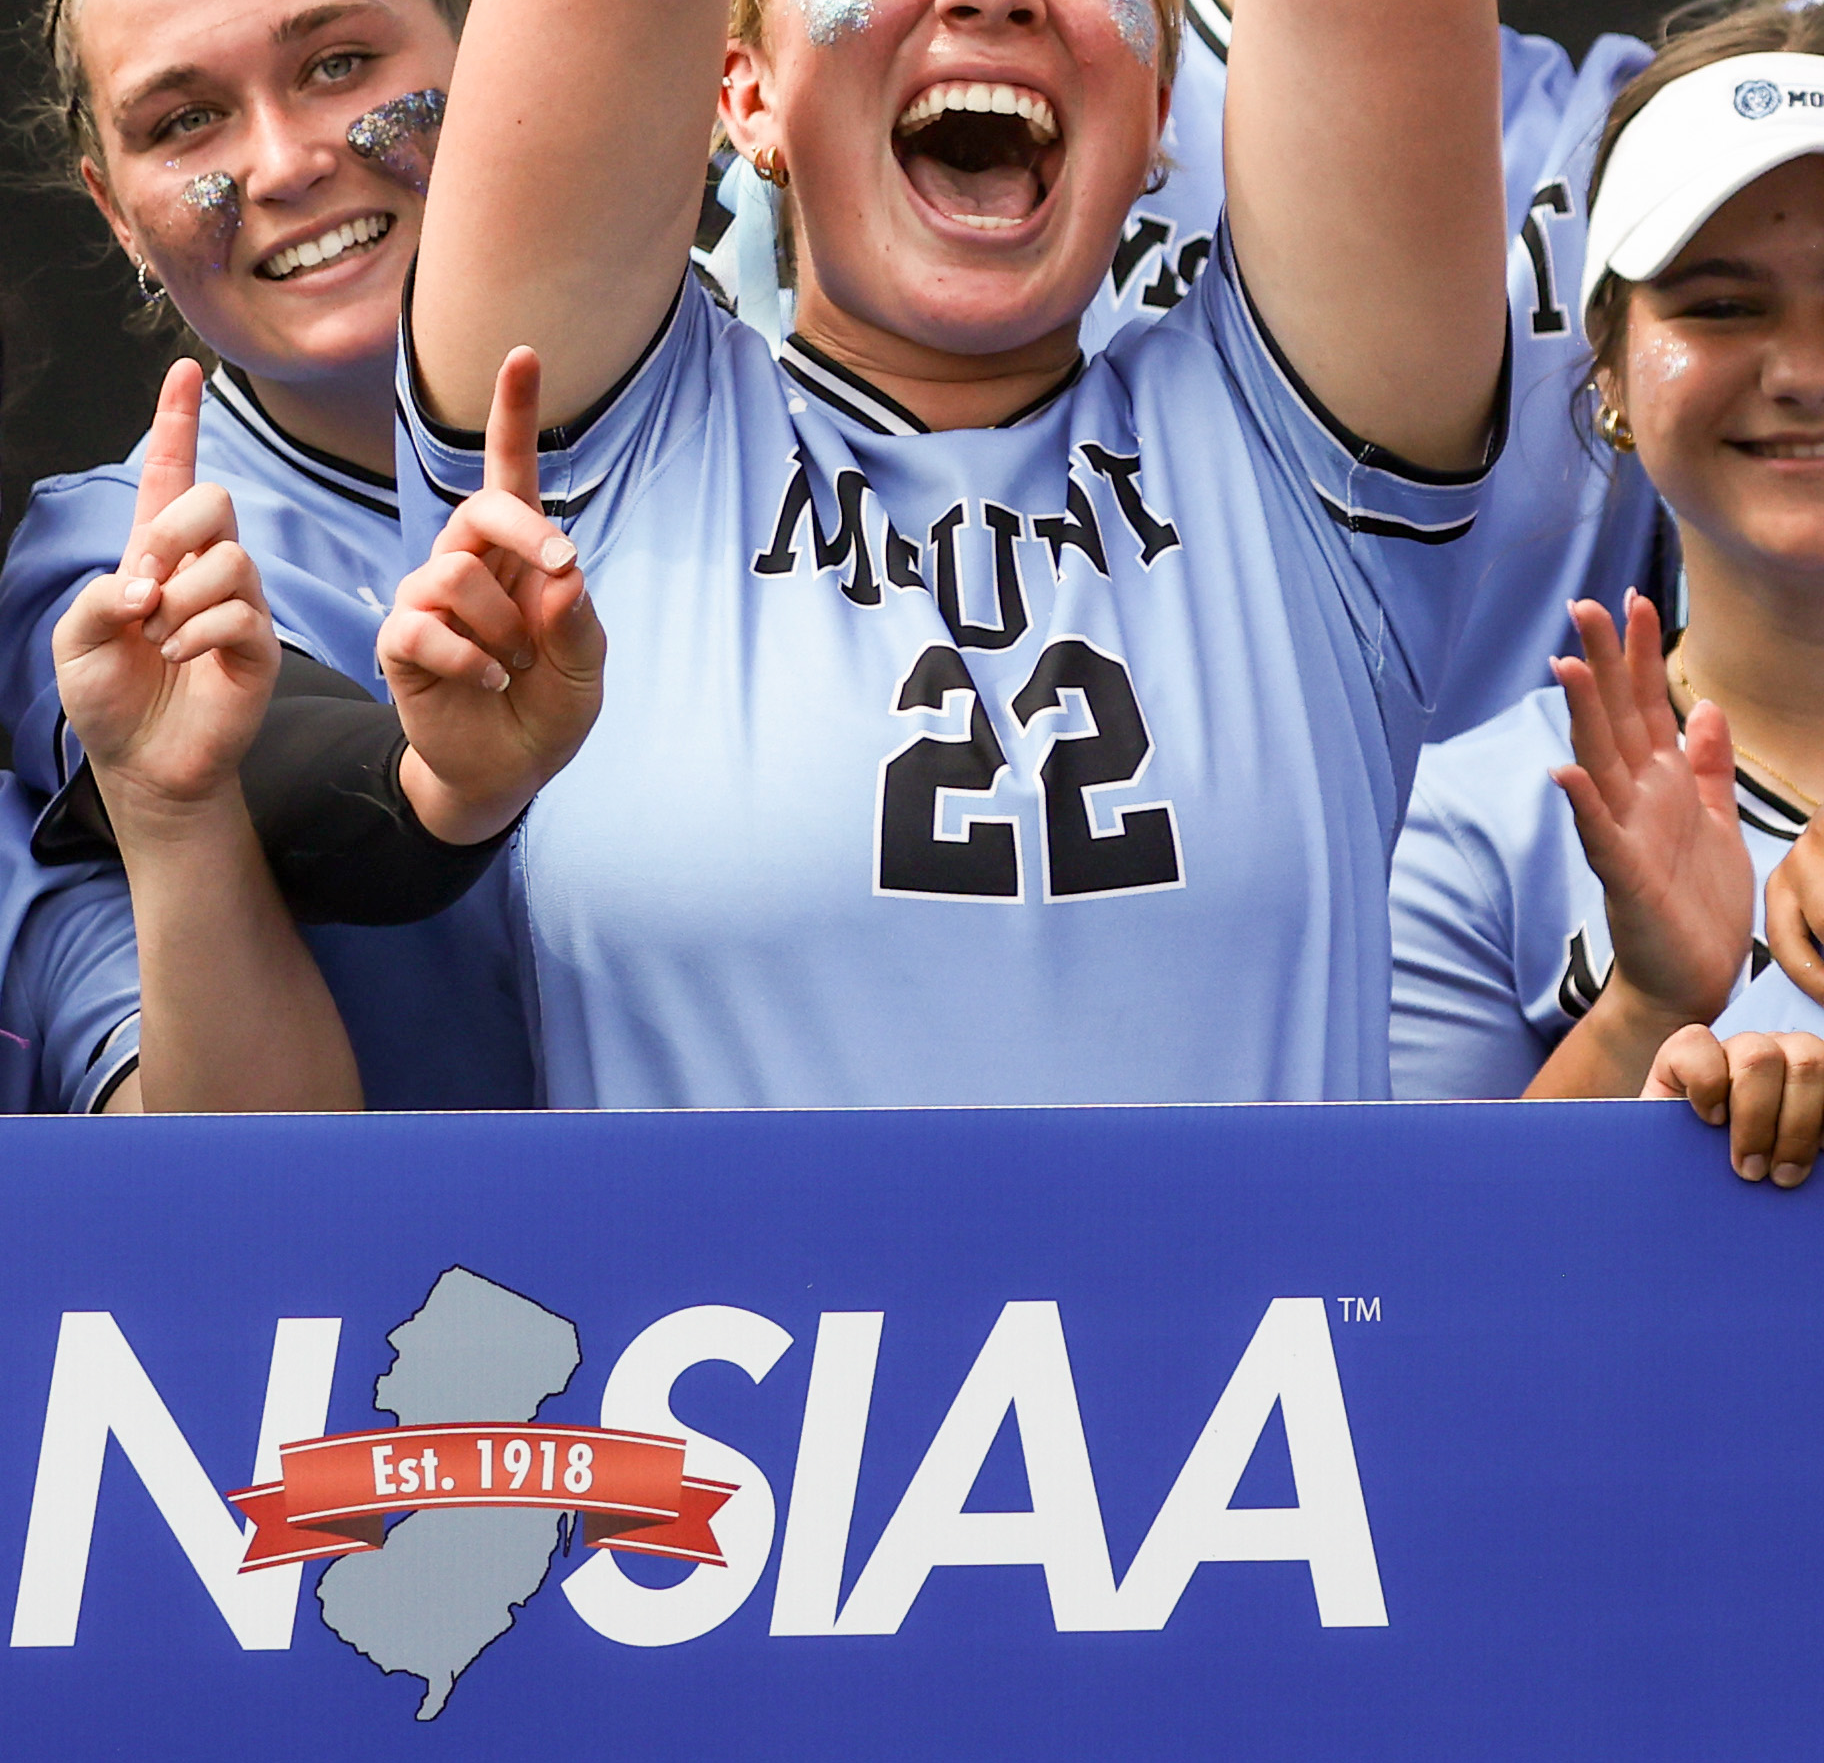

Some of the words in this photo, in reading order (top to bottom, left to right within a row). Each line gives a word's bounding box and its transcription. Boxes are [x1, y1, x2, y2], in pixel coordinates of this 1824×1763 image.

[872, 634, 1186, 904] 22
[372, 1444, 455, 1495] Est.
[477, 1439, 594, 1494] 1918
